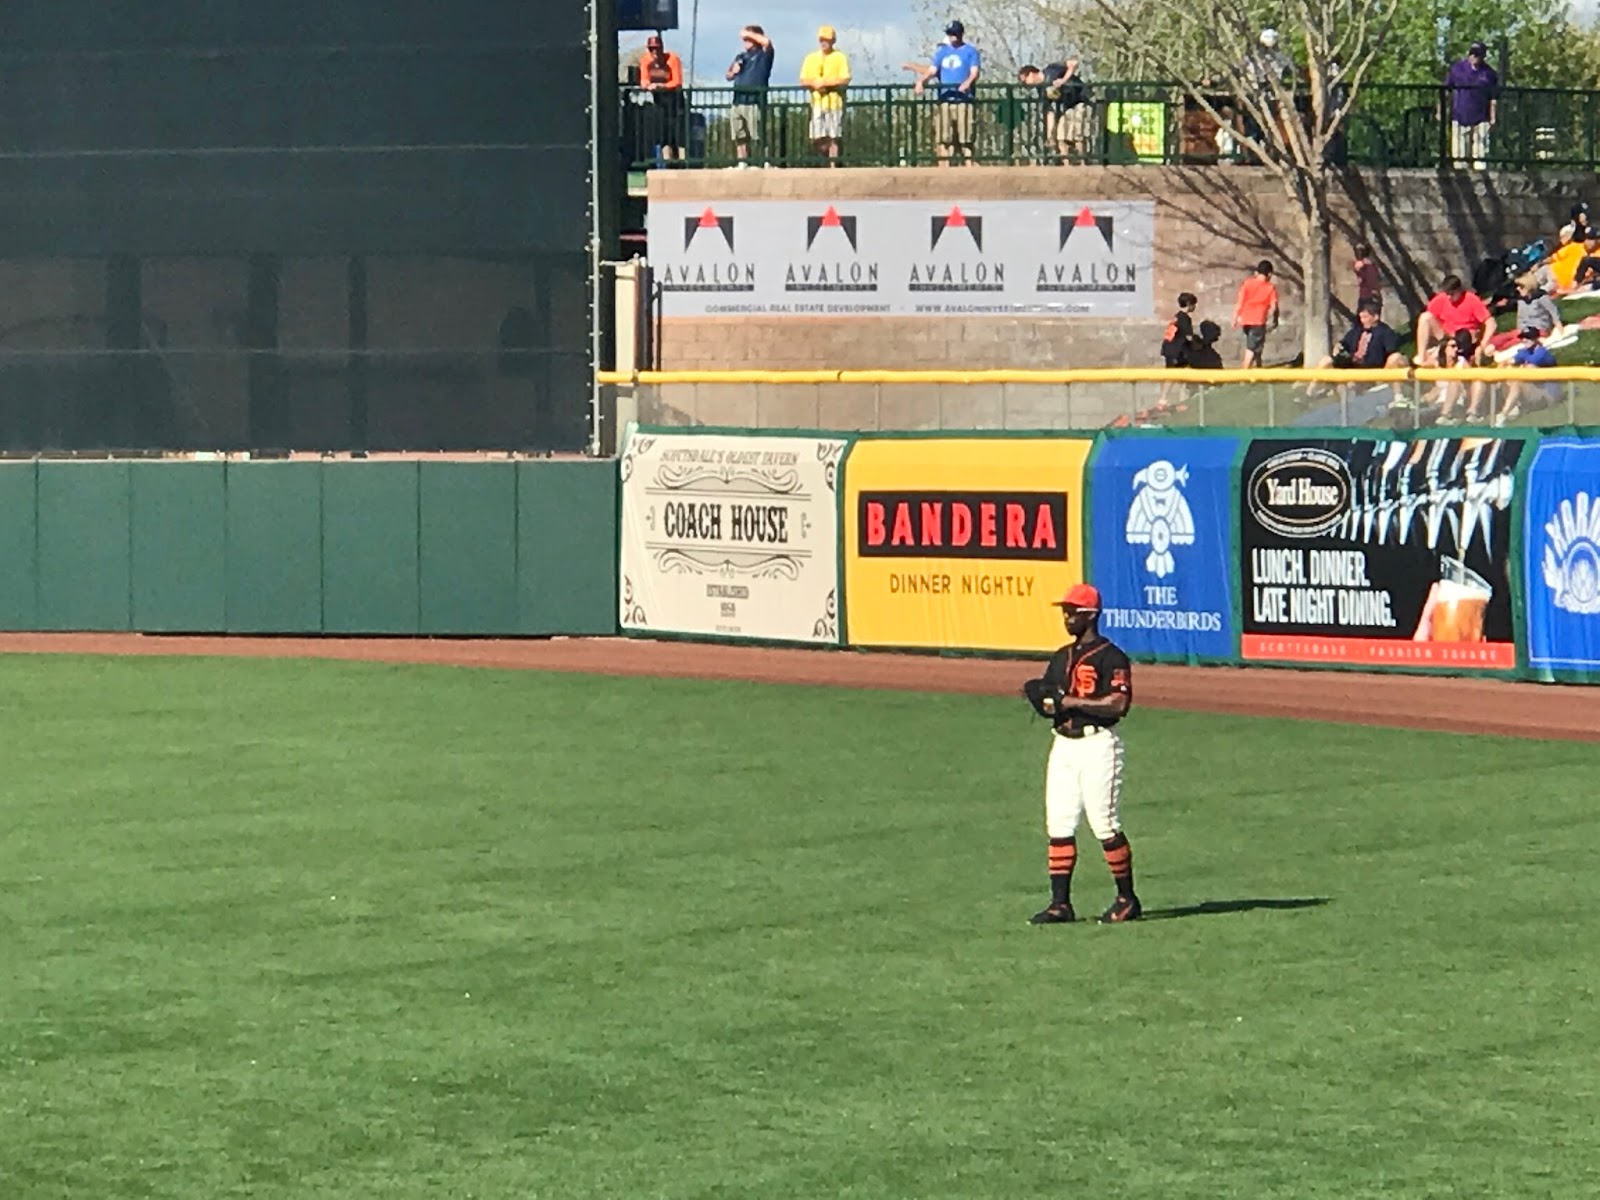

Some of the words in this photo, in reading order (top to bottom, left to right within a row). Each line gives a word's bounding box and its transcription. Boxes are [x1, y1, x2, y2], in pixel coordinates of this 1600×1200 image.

[664, 262, 754, 283] AVALON
[786, 261, 878, 283] AVALON
[910, 261, 1004, 283] AVALON
[1037, 262, 1136, 283] AVALON
[795, 304, 824, 312] ESTATE
[827, 304, 891, 313] DEVELOPMENT
[1266, 478, 1297, 505] Yard
[1298, 478, 1339, 505] House
[664, 502, 722, 540] COACH
[731, 505, 788, 543] HOUSE
[867, 502, 1057, 548] BANDERA
[1310, 549, 1371, 587] DINNER.
[890, 574, 951, 594] DINNER
[962, 576, 1034, 596] NIGHTLY
[1144, 585, 1178, 605] THE
[1253, 586, 1288, 623] LATE
[1290, 588, 1336, 625] NIGHT
[1338, 589, 1396, 627] DINING.
[1102, 608, 1222, 631] THUNDERBIRDS
